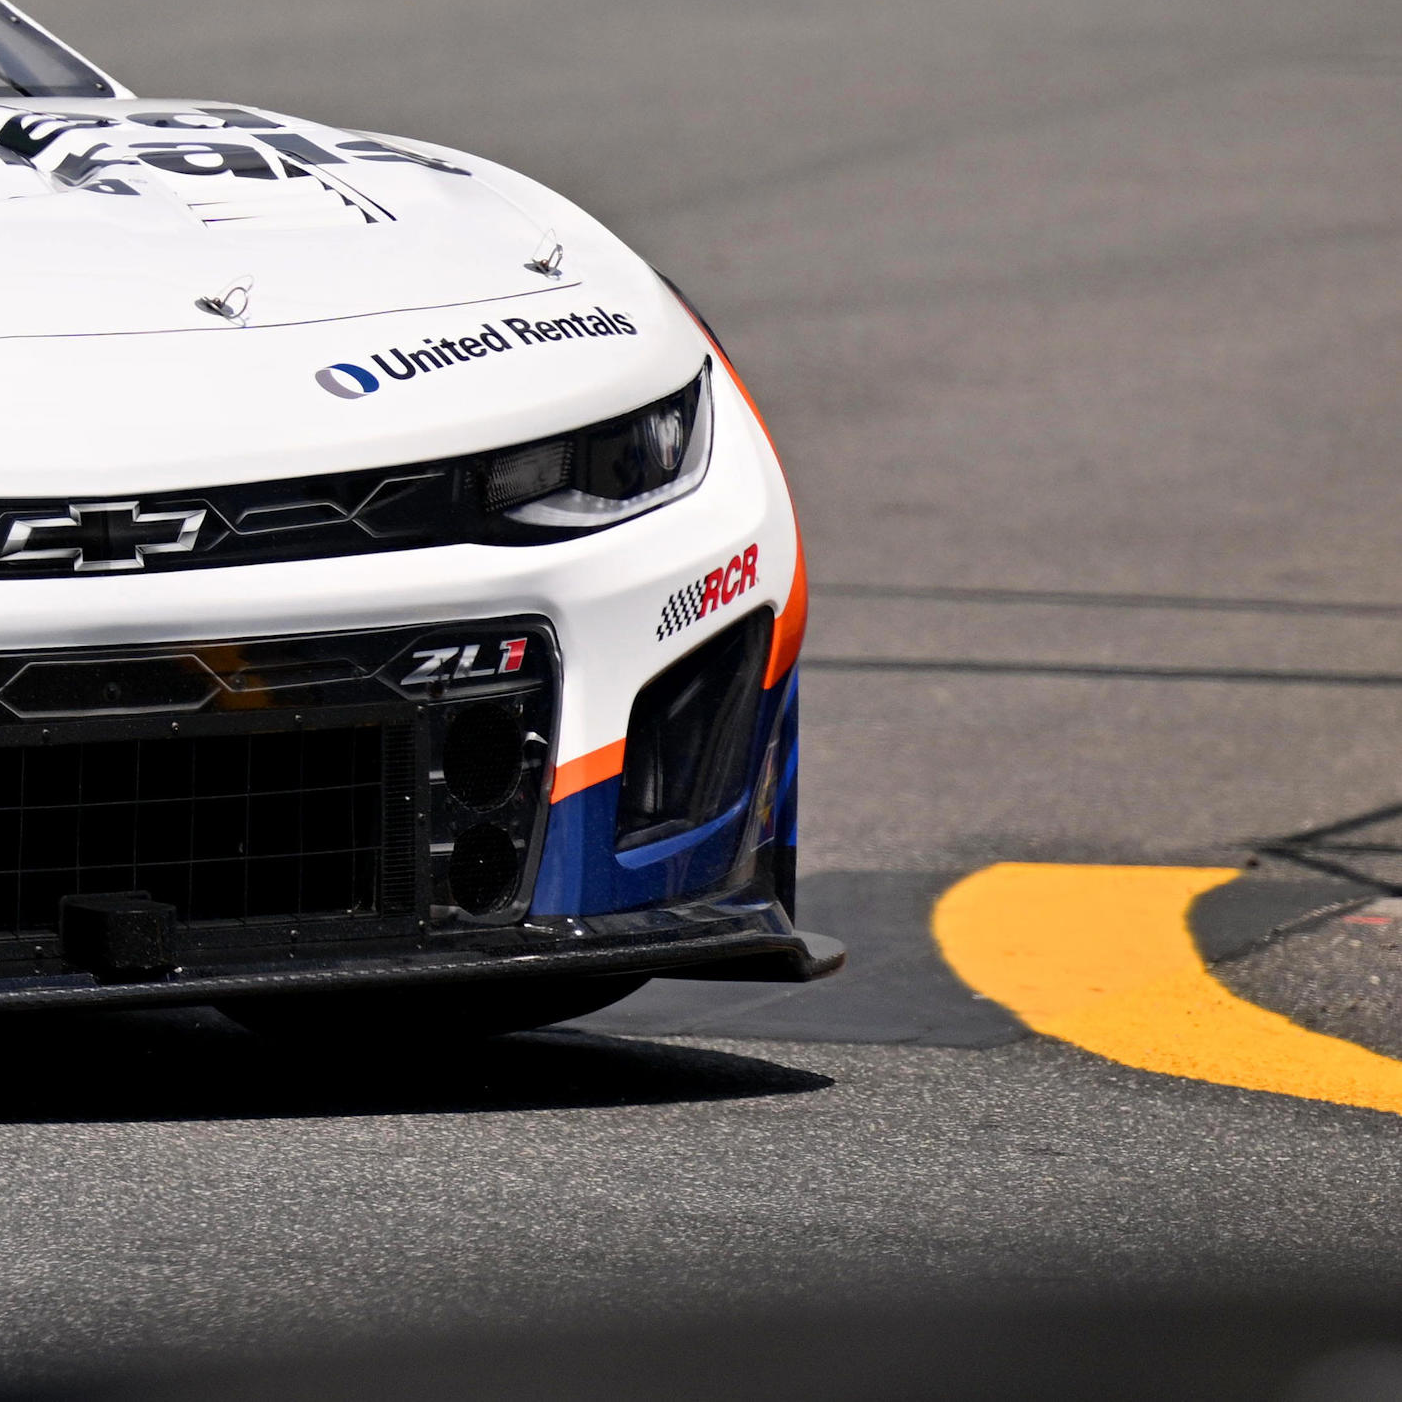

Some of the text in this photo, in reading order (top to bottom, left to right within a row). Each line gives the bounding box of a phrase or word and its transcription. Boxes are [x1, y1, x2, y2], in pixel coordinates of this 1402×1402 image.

[371, 306, 638, 381] United Rentals
[699, 542, 760, 619] RCR
[400, 636, 529, 686] ZL1
